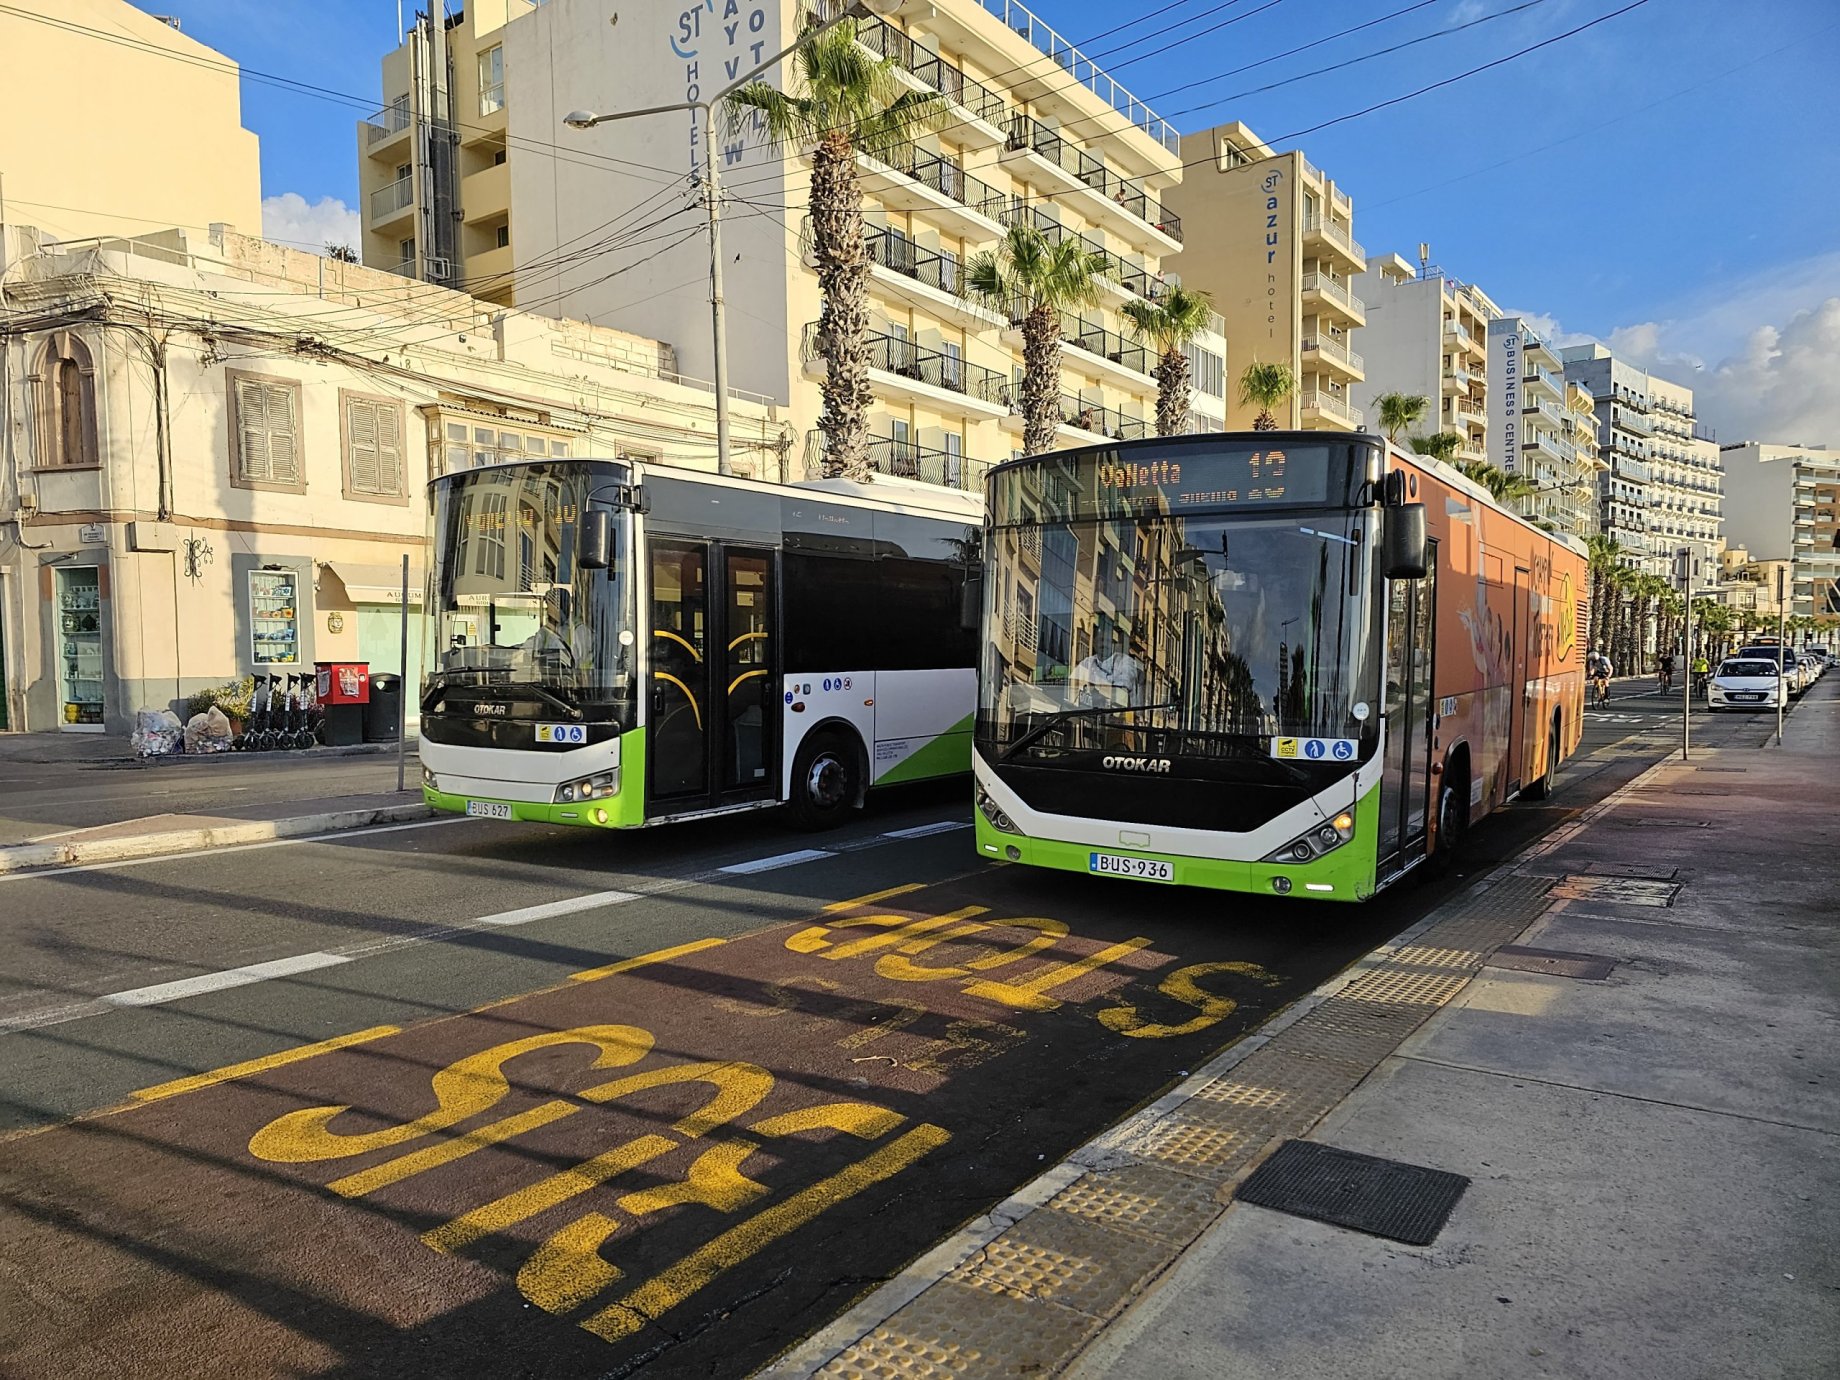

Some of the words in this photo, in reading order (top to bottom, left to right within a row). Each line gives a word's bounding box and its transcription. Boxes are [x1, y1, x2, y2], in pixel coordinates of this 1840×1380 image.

[679, 4, 703, 43] ST
[1265, 175, 1278, 188] ST
[1266, 196, 1278, 263] azur
[1267, 273, 1275, 338] hotel
[1506, 350, 1515, 416] BUSINESS
[1505, 423, 1514, 471] CENTRE
[474, 704, 506, 715] OTOKAR
[1102, 756, 1170, 774] OTOKAR
[472, 803, 488, 815] BUS
[492, 805, 508, 817] 627
[1138, 861, 1168, 878] 936
[783, 905, 1280, 1038] STOP
[248, 1024, 952, 1343] BUS
